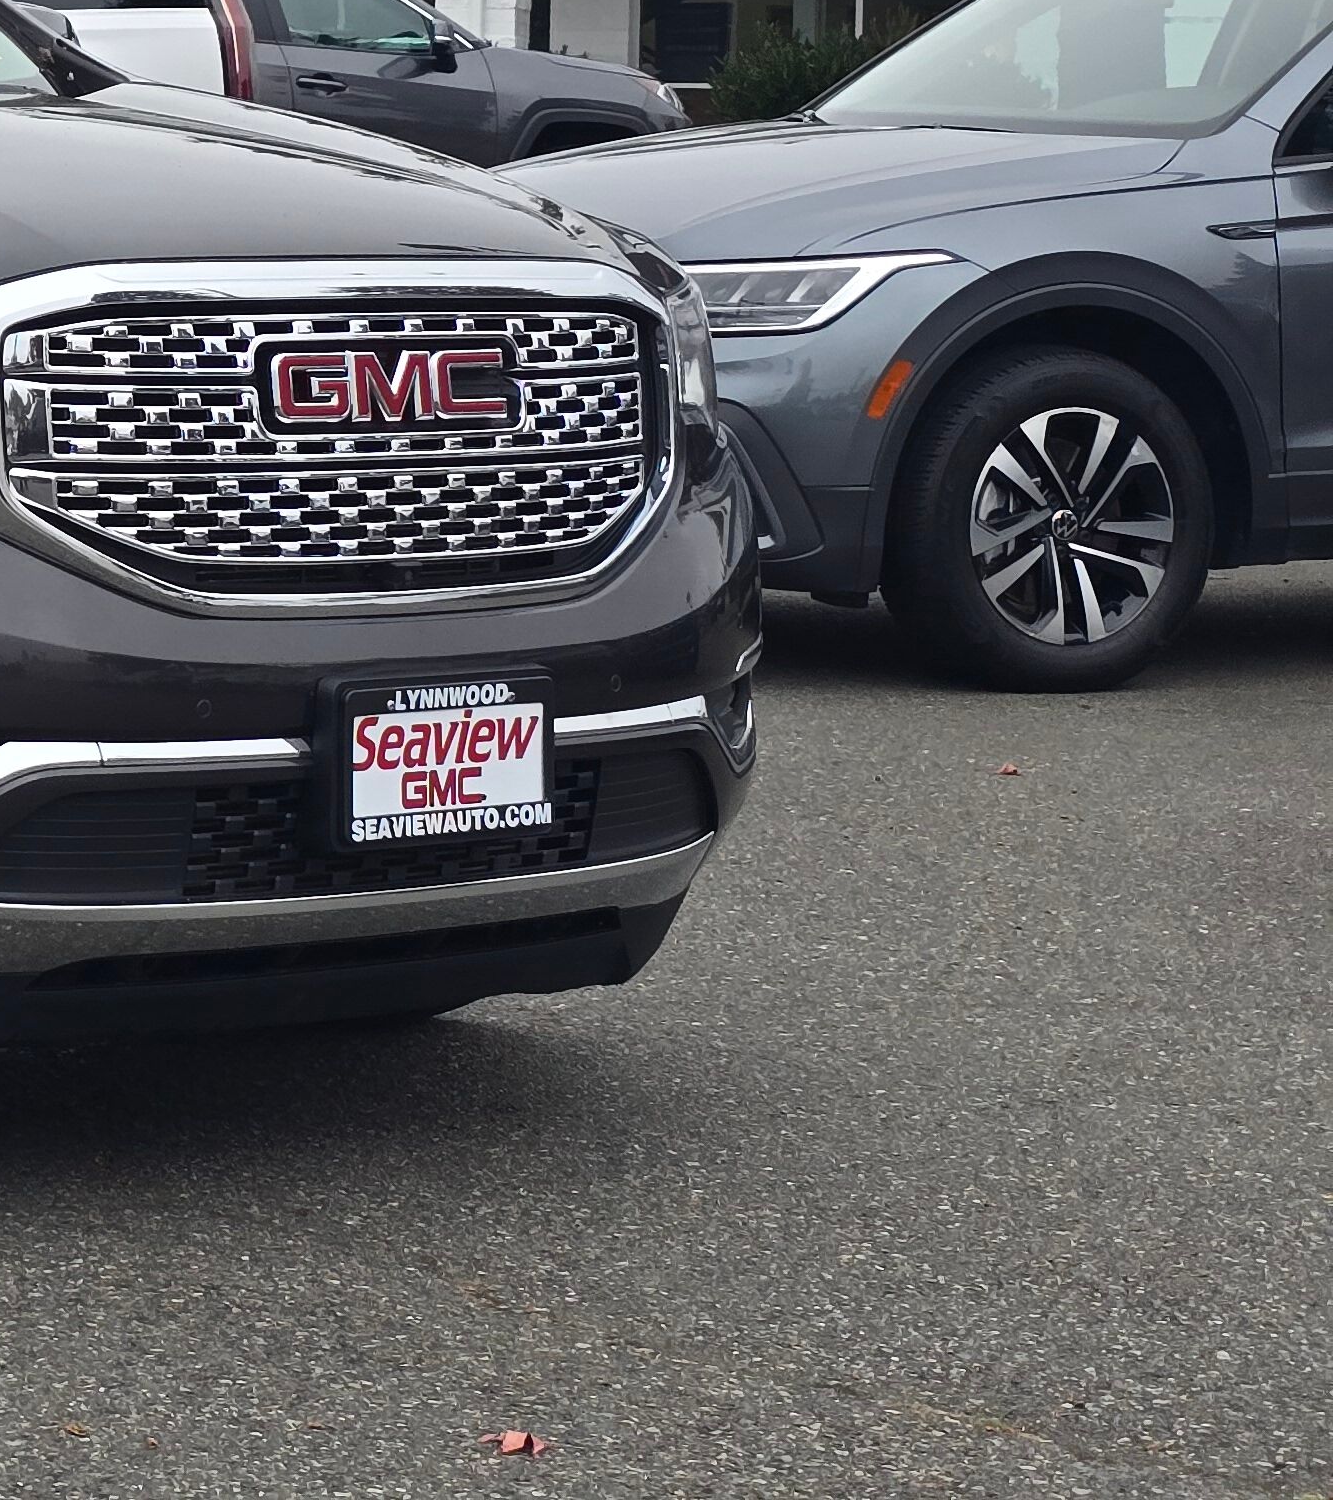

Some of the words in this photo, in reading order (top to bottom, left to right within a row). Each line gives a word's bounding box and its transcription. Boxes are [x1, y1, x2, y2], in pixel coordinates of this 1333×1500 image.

[270, 347, 508, 424] GMC
[395, 683, 509, 711] LYNNWOOD
[352, 709, 539, 772] Seaview
[401, 766, 486, 810] GMC
[351, 802, 552, 842] SEAVIEWAUTO.COM
